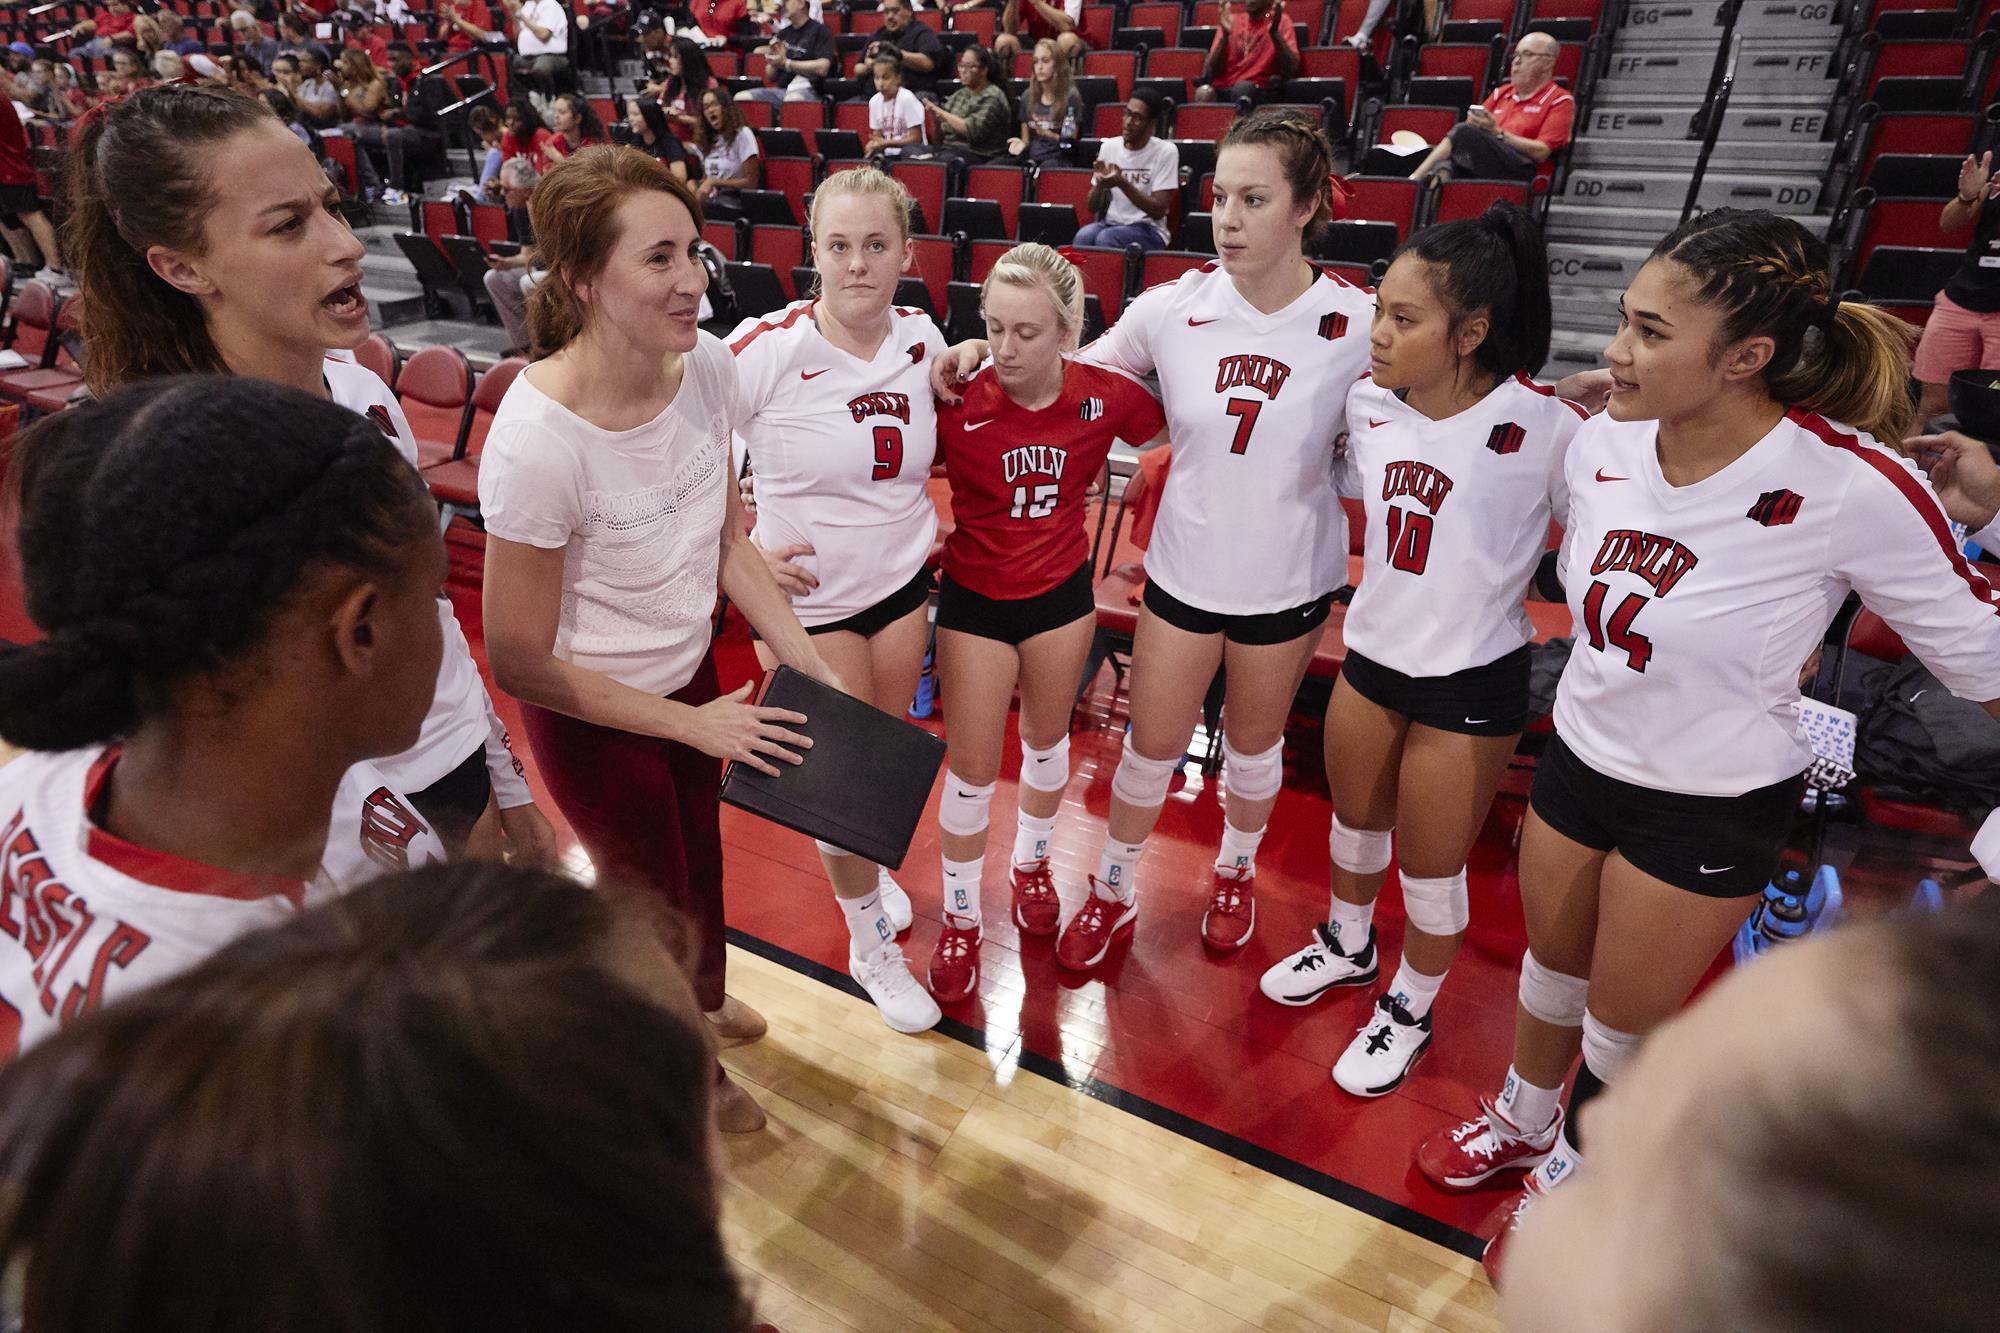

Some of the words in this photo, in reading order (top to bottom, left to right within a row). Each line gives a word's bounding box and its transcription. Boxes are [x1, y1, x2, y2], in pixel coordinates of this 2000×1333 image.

[1632, 10, 1659, 25] GG
[1799, 4, 1828, 20] GG
[1618, 57, 1642, 72] FF
[1796, 56, 1824, 71] FF
[1597, 114, 1625, 130] EE
[1790, 116, 1821, 133] EE
[1574, 179, 1603, 197] DD
[1777, 187, 1812, 205] DD
[1549, 258, 1580, 277] CC
[1215, 354, 1291, 400] UNLV
[847, 391, 910, 425] UNLV
[1226, 397, 1263, 456] 7
[871, 425, 904, 481] 9
[1001, 445, 1068, 484] UNLV
[1010, 483, 1060, 519] 15
[1382, 460, 1454, 516] UNLV
[1386, 504, 1433, 576] 10
[1590, 529, 1699, 599] UNLV
[1583, 580, 1653, 674] 14
